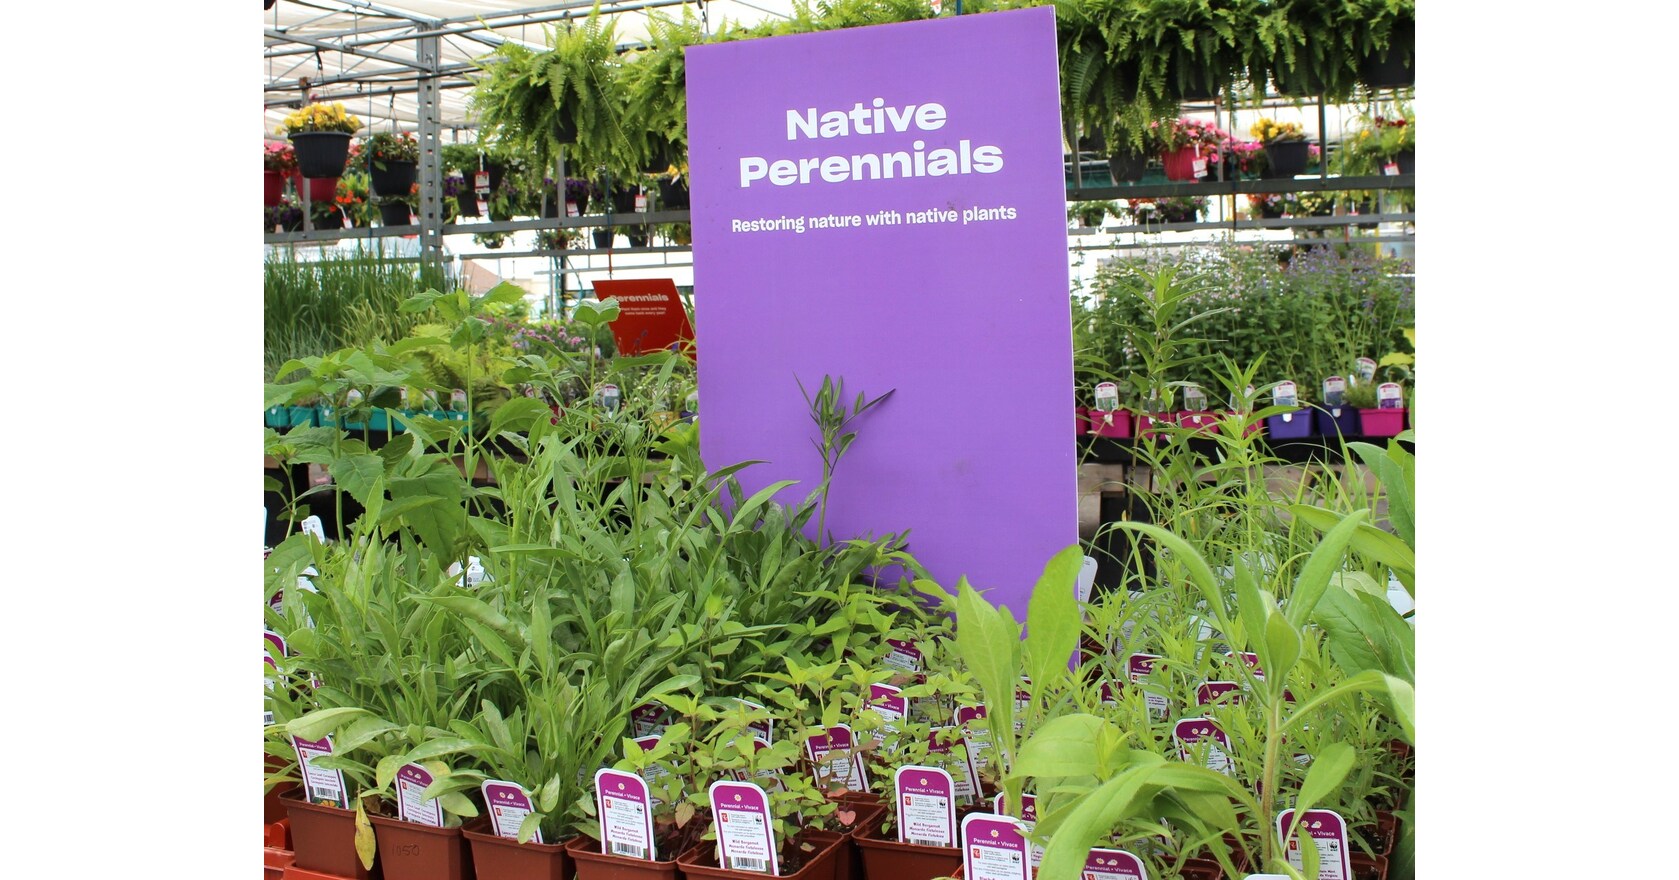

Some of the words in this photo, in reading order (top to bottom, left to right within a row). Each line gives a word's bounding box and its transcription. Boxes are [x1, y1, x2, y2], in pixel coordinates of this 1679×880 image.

[786, 97, 947, 141] Native
[739, 139, 1004, 188] Perennials
[731, 217, 806, 234] Restoring
[808, 213, 862, 229] nature
[865, 209, 902, 226] with
[905, 206, 959, 225] native
[962, 205, 1017, 225] plants
[605, 789, 623, 797] Perennial
[973, 837, 997, 845] Perennial
[1085, 864, 1110, 872] Perennial
